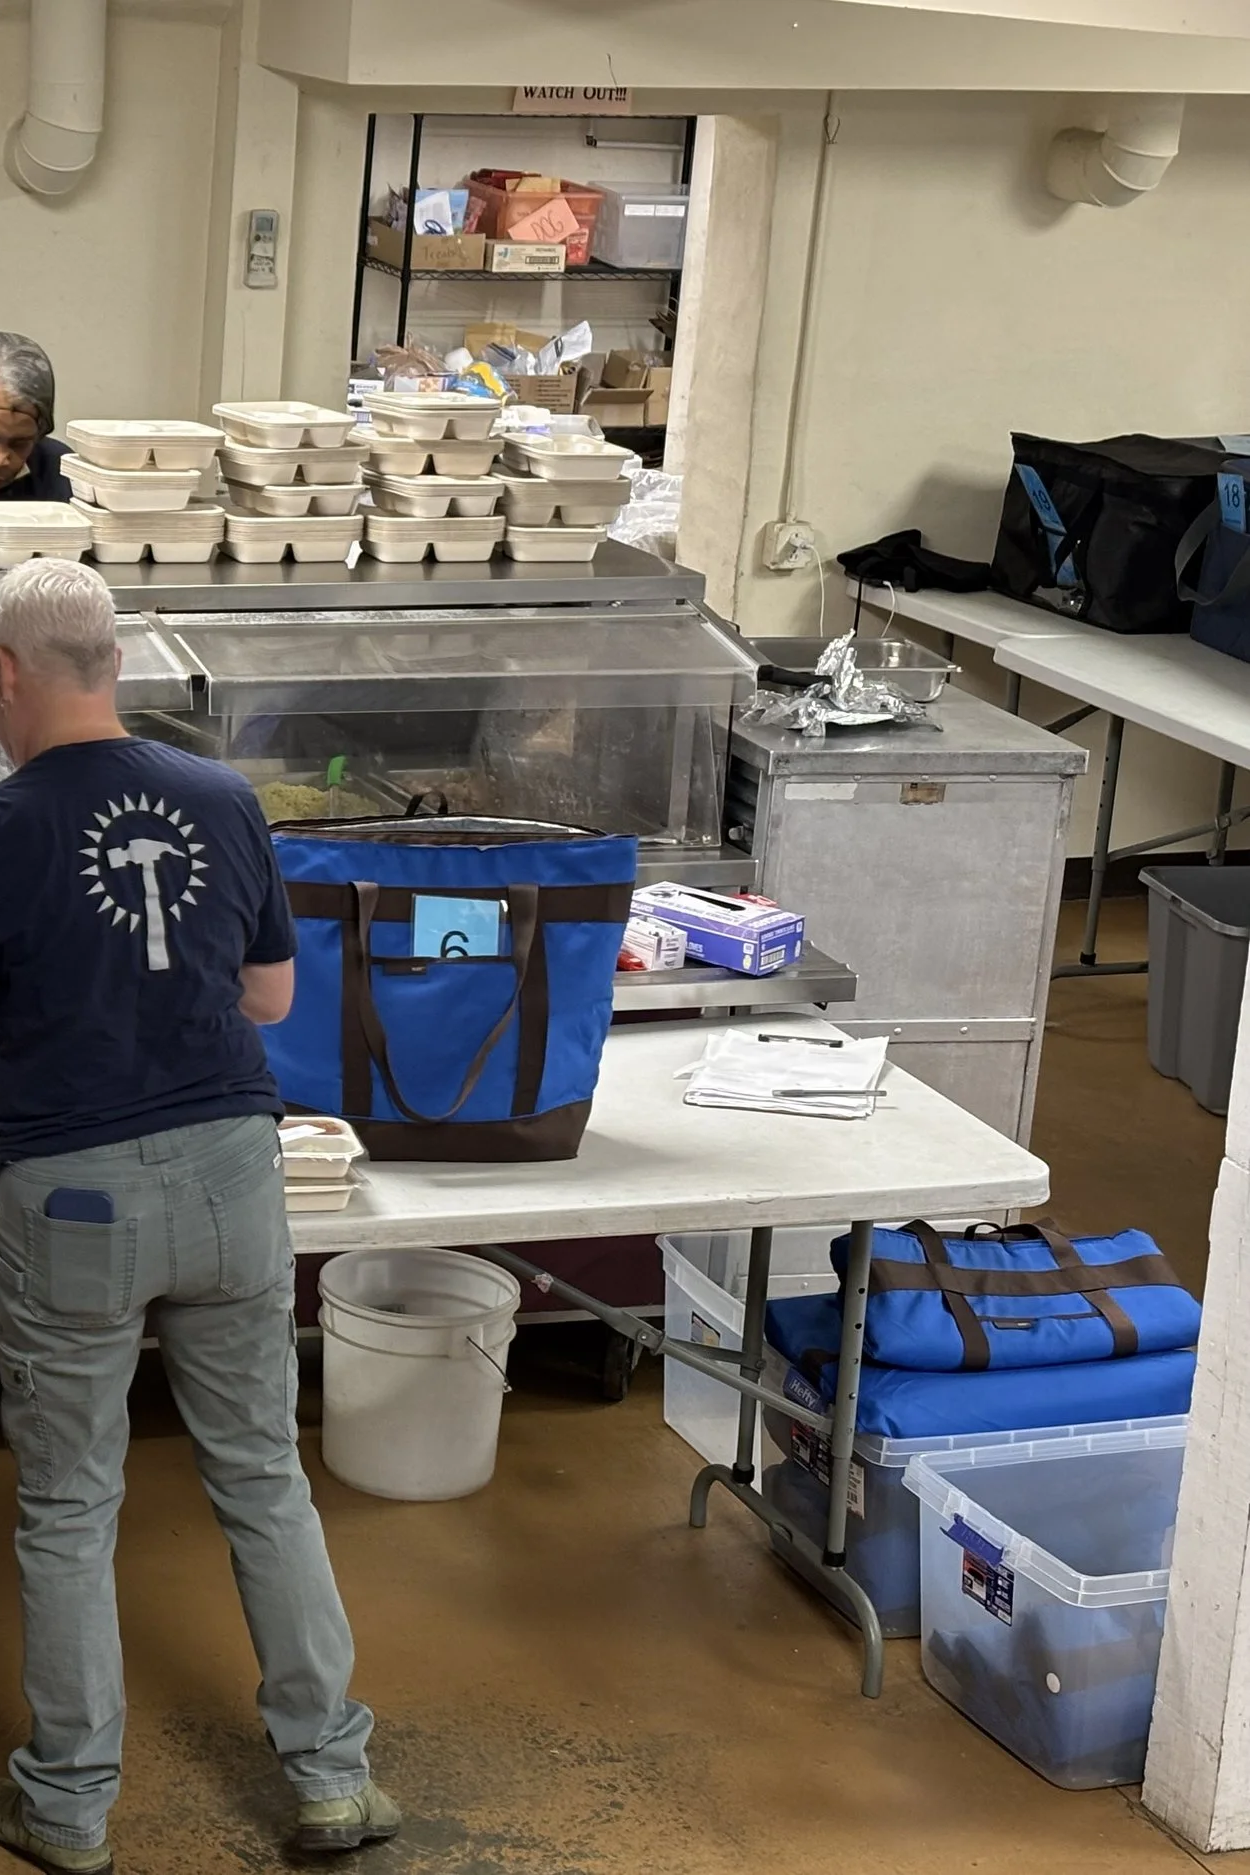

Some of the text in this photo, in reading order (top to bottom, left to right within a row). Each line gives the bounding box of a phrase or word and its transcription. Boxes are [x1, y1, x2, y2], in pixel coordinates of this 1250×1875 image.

[523, 86, 627, 101] WATCH OUT!!!
[1032, 490, 1052, 511] 19
[1224, 483, 1241, 508] 18
[440, 930, 469, 958] 6
[790, 1379, 816, 1407] Hefty
